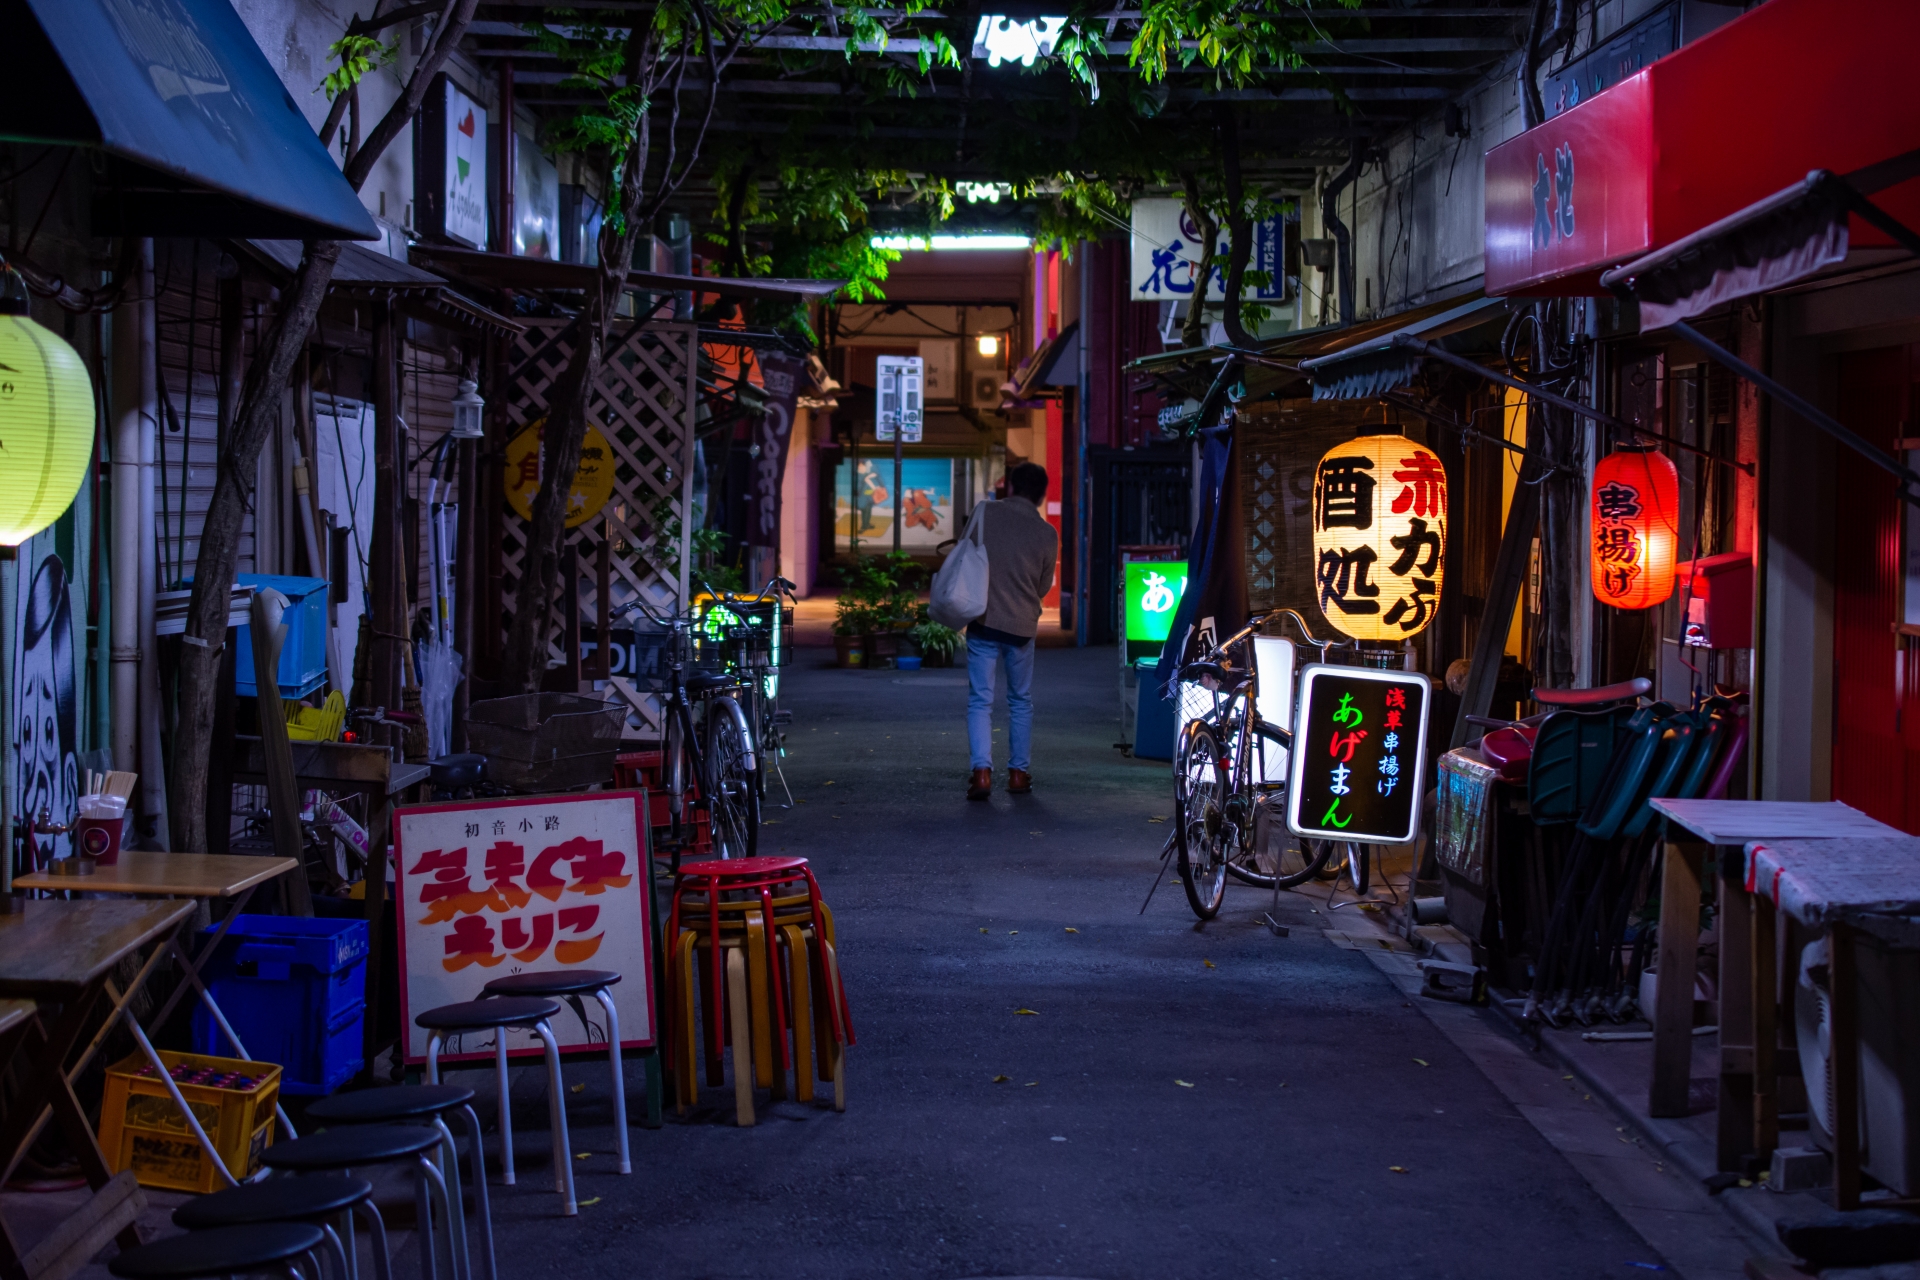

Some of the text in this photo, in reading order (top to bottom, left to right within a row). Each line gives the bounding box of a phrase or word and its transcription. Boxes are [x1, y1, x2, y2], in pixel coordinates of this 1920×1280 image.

[1315, 455, 1381, 615] 酒処
[1597, 480, 1643, 598] 串揚げ
[1321, 692, 1368, 828] あげまん
[464, 814, 561, 838] 初音小路
